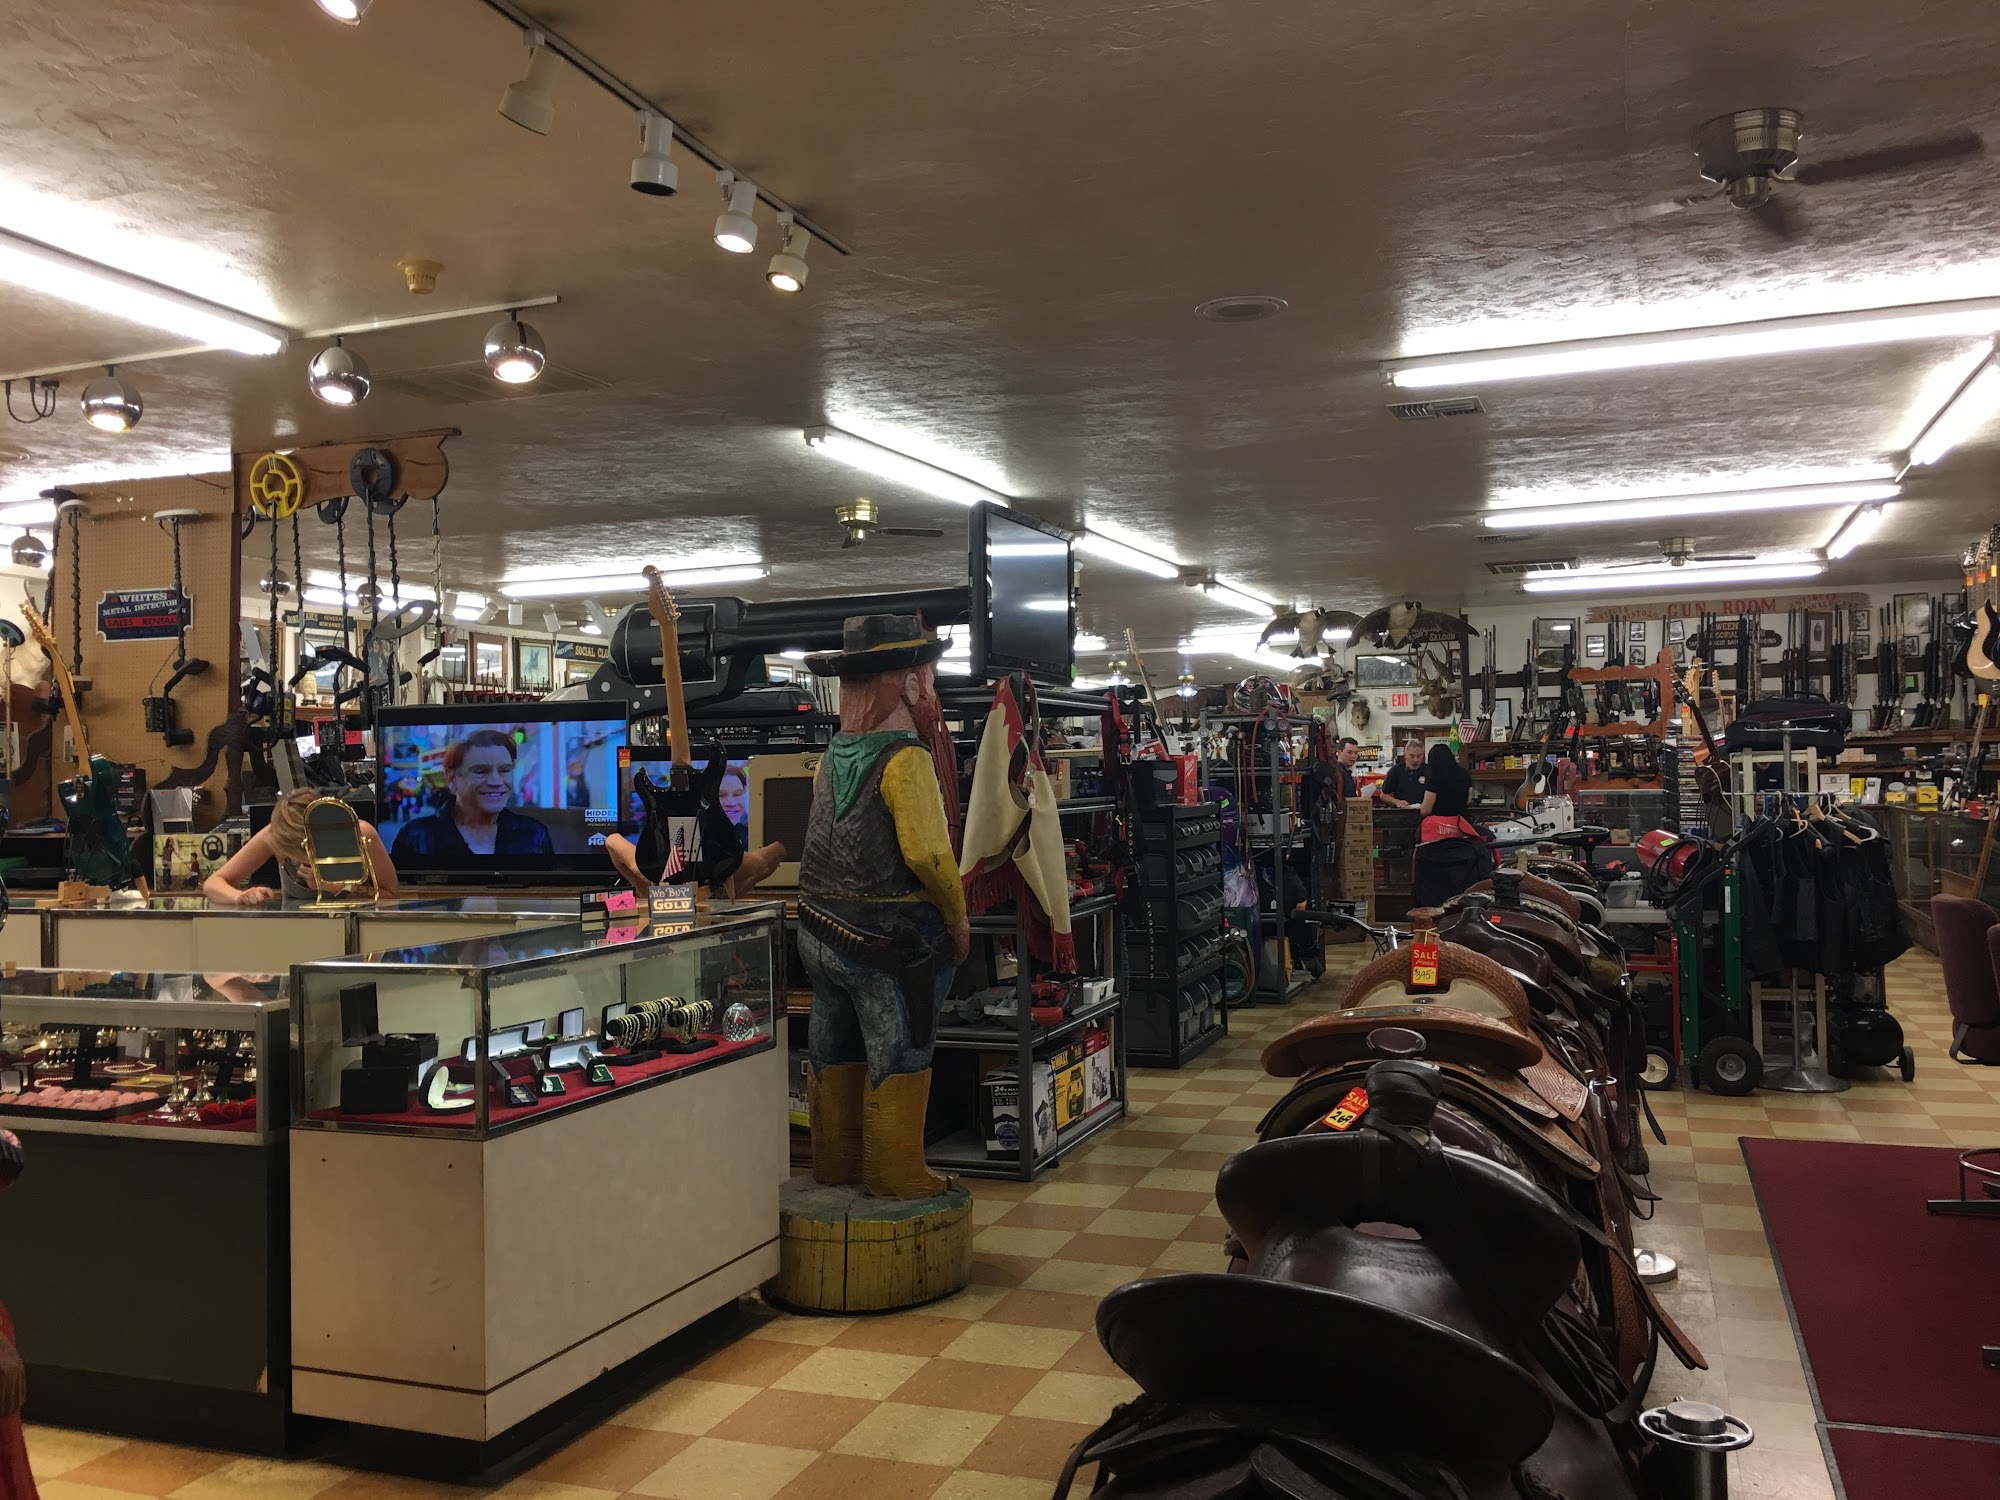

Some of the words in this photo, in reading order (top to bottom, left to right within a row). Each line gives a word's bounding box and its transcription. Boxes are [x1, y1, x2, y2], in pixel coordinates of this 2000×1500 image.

[102, 606, 132, 616] METAL
[1668, 602, 1706, 617] GUN
[1723, 598, 1777, 615] ROOM
[107, 618, 134, 627] SALES
[1429, 633, 1456, 641] SALOON
[575, 645, 596, 657] SOCIAL
[1392, 693, 1409, 707] EXIT
[653, 898, 692, 910] GOLD
[1413, 949, 1438, 960] SALE
[1345, 1091, 1369, 1108] SALE
